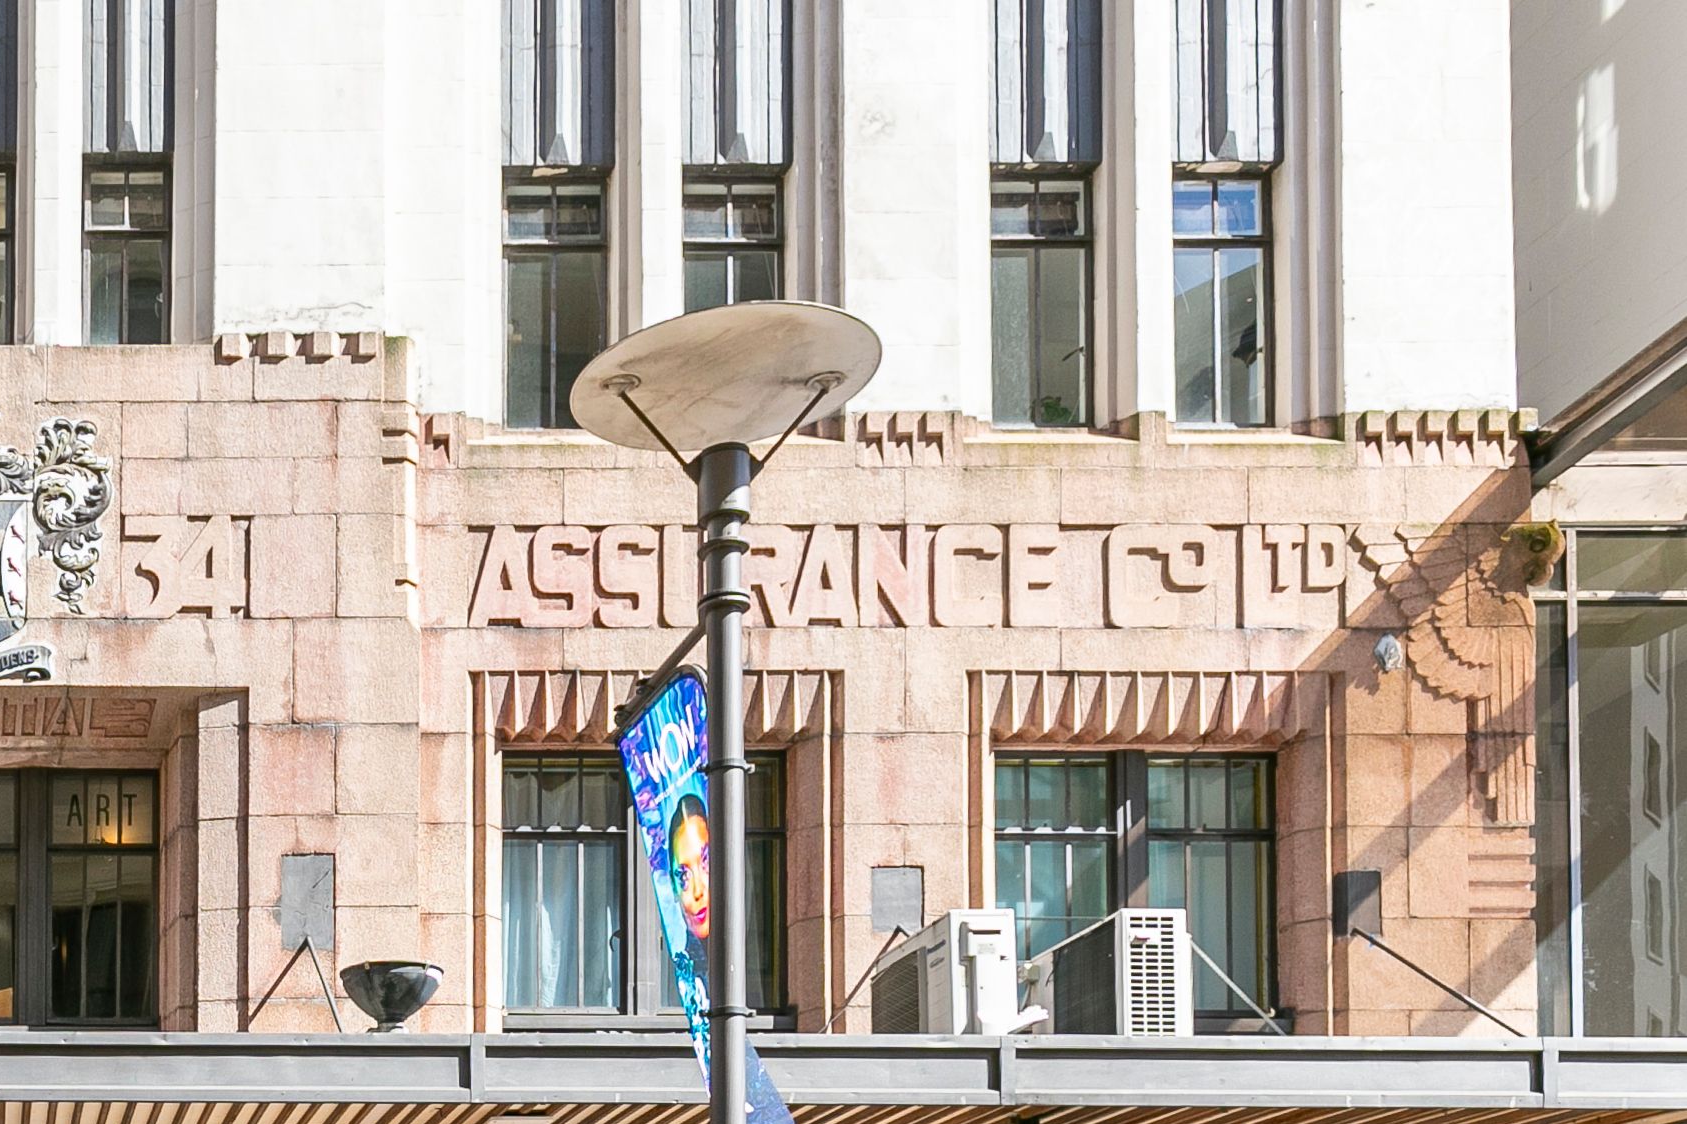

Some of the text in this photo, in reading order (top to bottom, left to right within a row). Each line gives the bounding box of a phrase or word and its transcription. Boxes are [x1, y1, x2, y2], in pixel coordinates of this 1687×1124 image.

[468, 523, 1058, 629] ASSURANCE
[1241, 523, 1347, 629] LTD
[66, 793, 138, 828] ART
